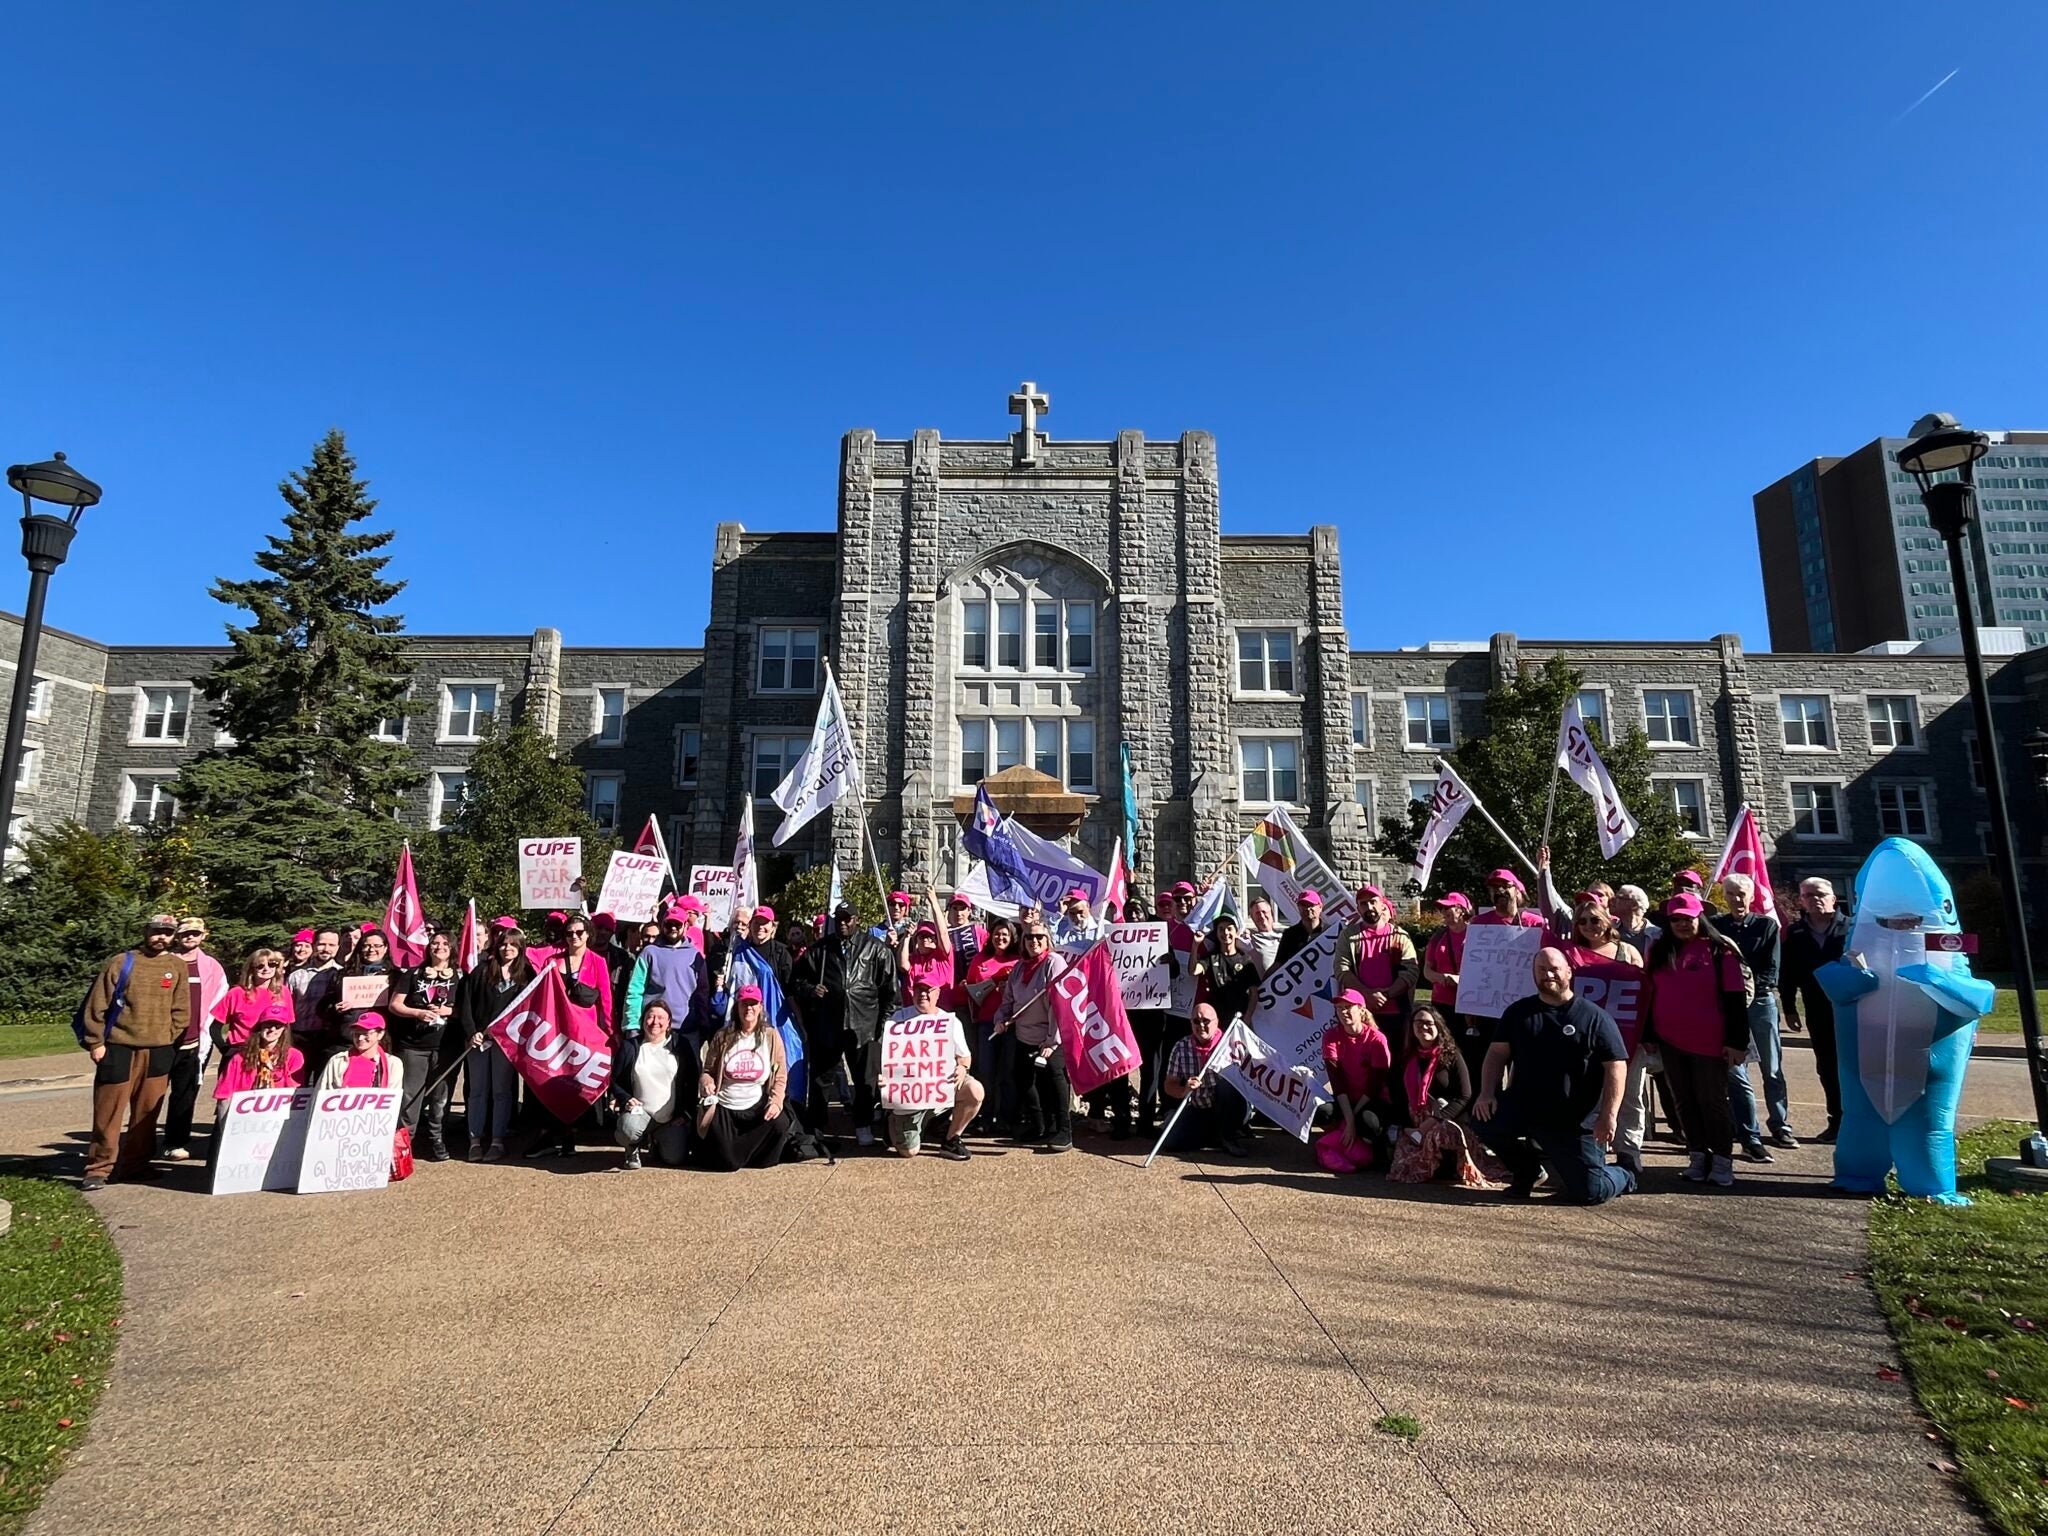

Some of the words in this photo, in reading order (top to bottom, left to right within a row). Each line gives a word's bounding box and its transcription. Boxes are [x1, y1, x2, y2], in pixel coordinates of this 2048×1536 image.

[524, 842, 576, 857] CUPE
[535, 858, 557, 867] FOR
[615, 856, 663, 873] CUPE
[526, 869, 571, 885] FAIR
[694, 870, 737, 883] CUPE
[532, 887, 572, 900] DEAL
[1111, 928, 1160, 944] CUPE
[1112, 946, 1157, 969] Honk
[1469, 948, 1533, 970] STOPPE
[1120, 971, 1137, 982] For
[1141, 971, 1149, 982] A
[1573, 976, 1641, 1020] PE
[889, 1018, 949, 1036] CUPE
[1054, 967, 1133, 1073] CUPE
[505, 1011, 611, 1088] CUPE
[889, 1038, 949, 1059] PART
[883, 1060, 946, 1079] TIME
[888, 1080, 948, 1104] PROFS
[235, 1093, 312, 1115] CUPE
[321, 1094, 396, 1113] CUPE
[319, 1112, 393, 1140] HONK
[338, 1138, 371, 1158] For
[314, 1160, 326, 1178] a
